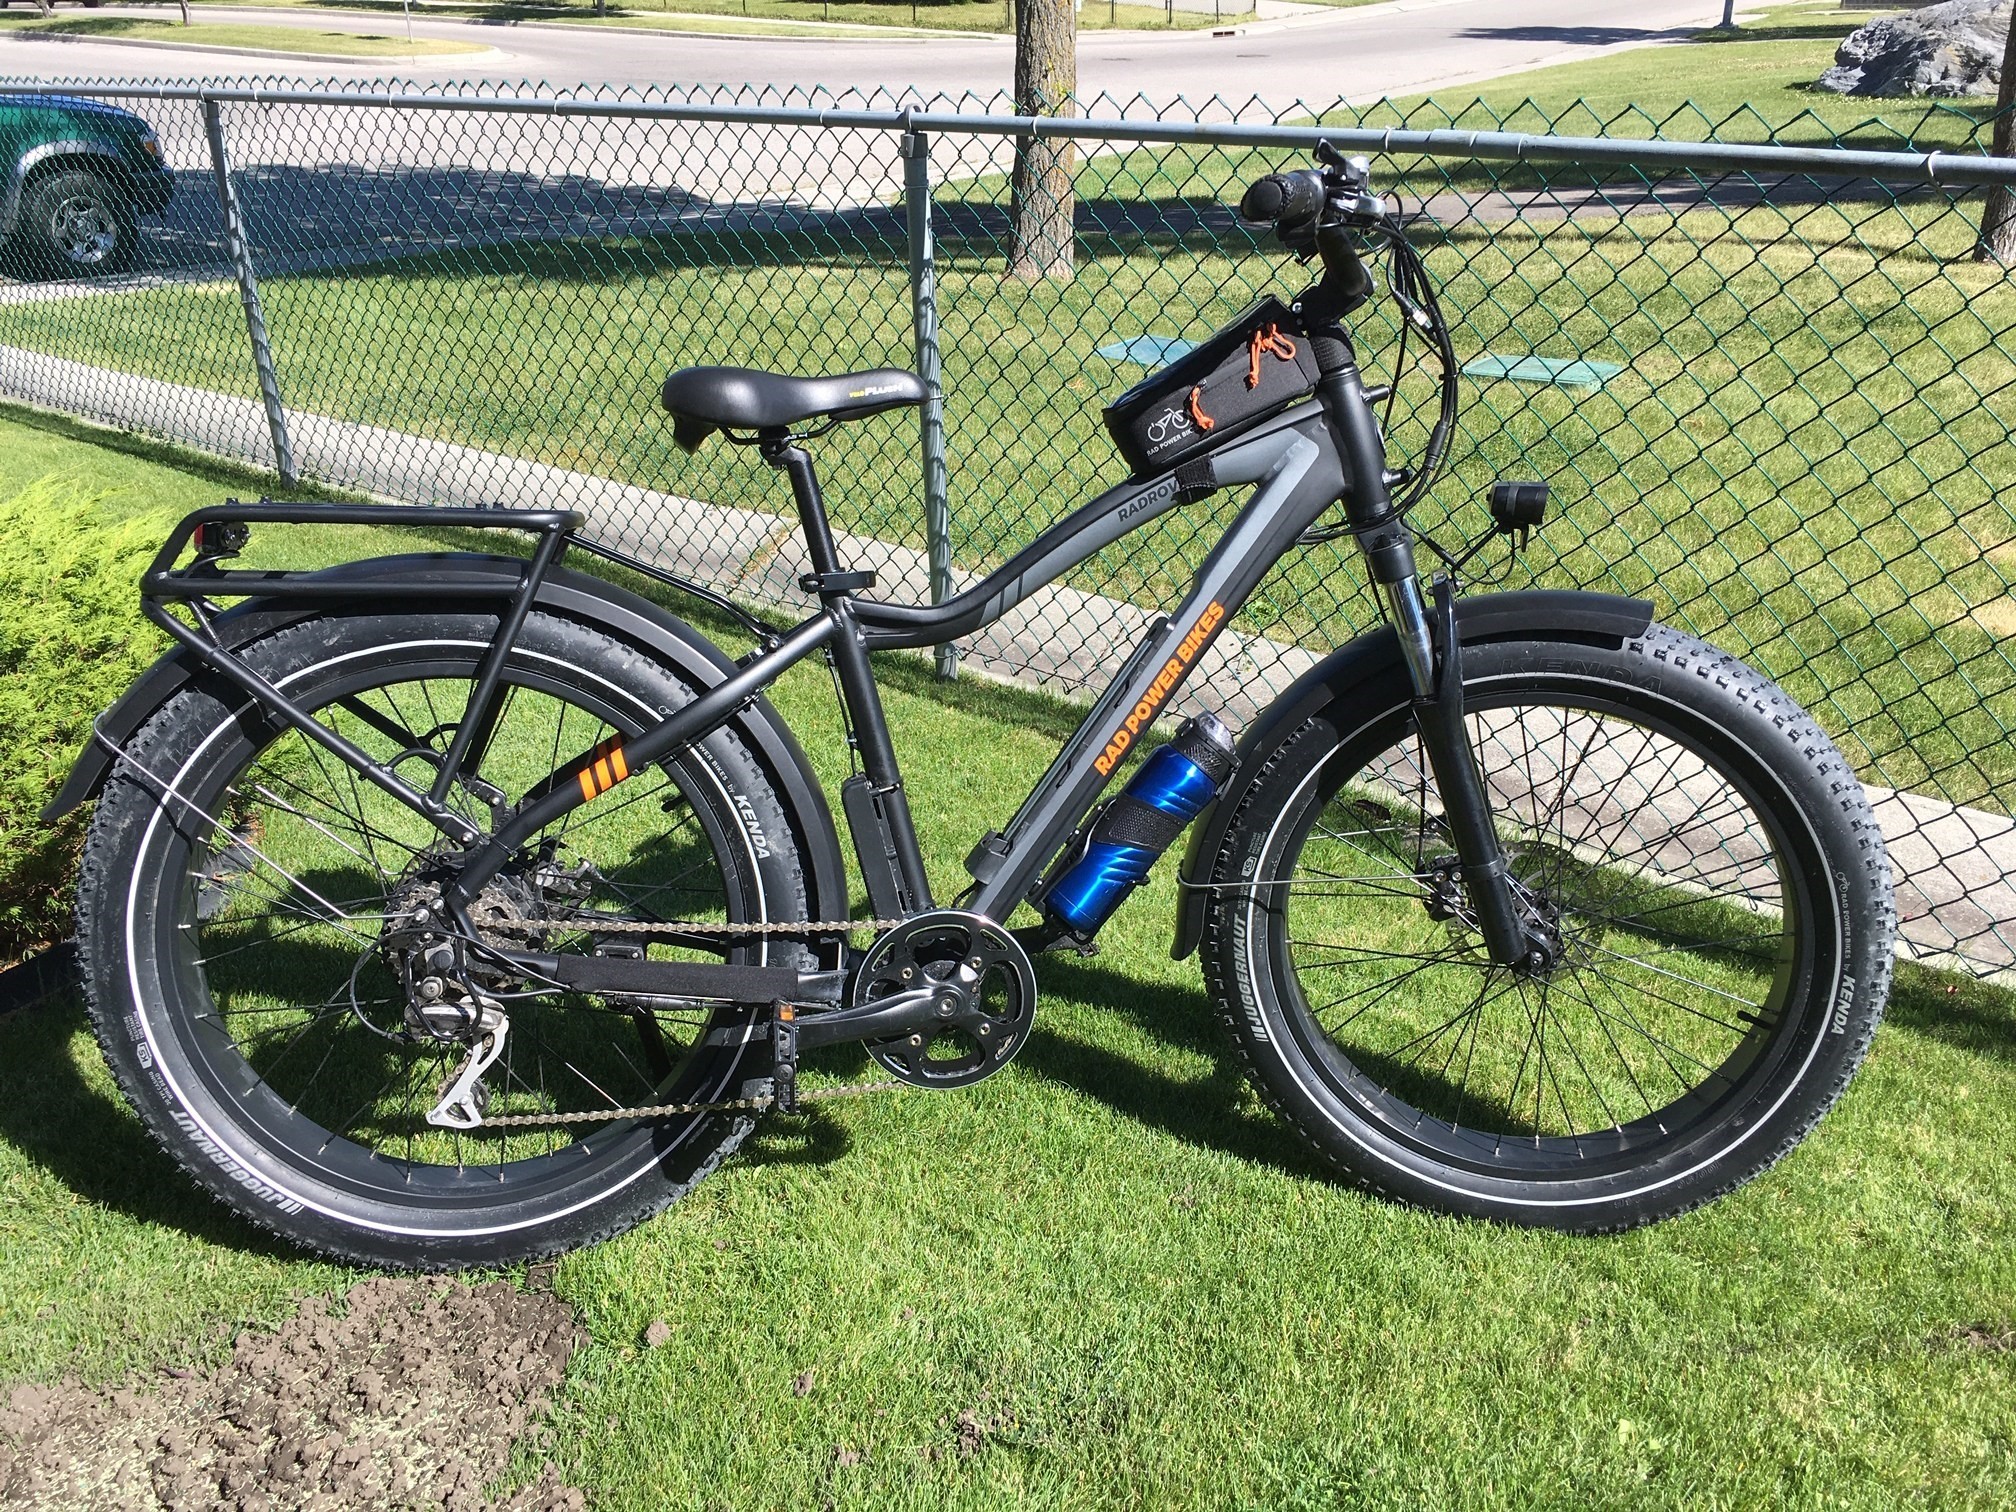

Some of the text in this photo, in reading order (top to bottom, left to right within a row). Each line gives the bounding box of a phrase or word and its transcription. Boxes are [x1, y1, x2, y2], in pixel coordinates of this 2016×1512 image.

[1146, 446, 1159, 457] RAD
[1160, 434, 1182, 450] POWER
[1117, 480, 1180, 522] RADROV
[1093, 601, 1225, 777] RAD POWER BIKES
[1500, 656, 1664, 697] KENDA
[711, 760, 728, 781] BIKES
[734, 794, 771, 860] KENDA
[1841, 893, 1849, 909] RAD
[1842, 910, 1851, 936] POWER
[1233, 912, 1263, 1026] JUGGERNAUT
[1844, 938, 1852, 959] BIKES
[1831, 973, 1856, 1035] KENDA
[168, 1109, 284, 1203] JUGGERNAUT
